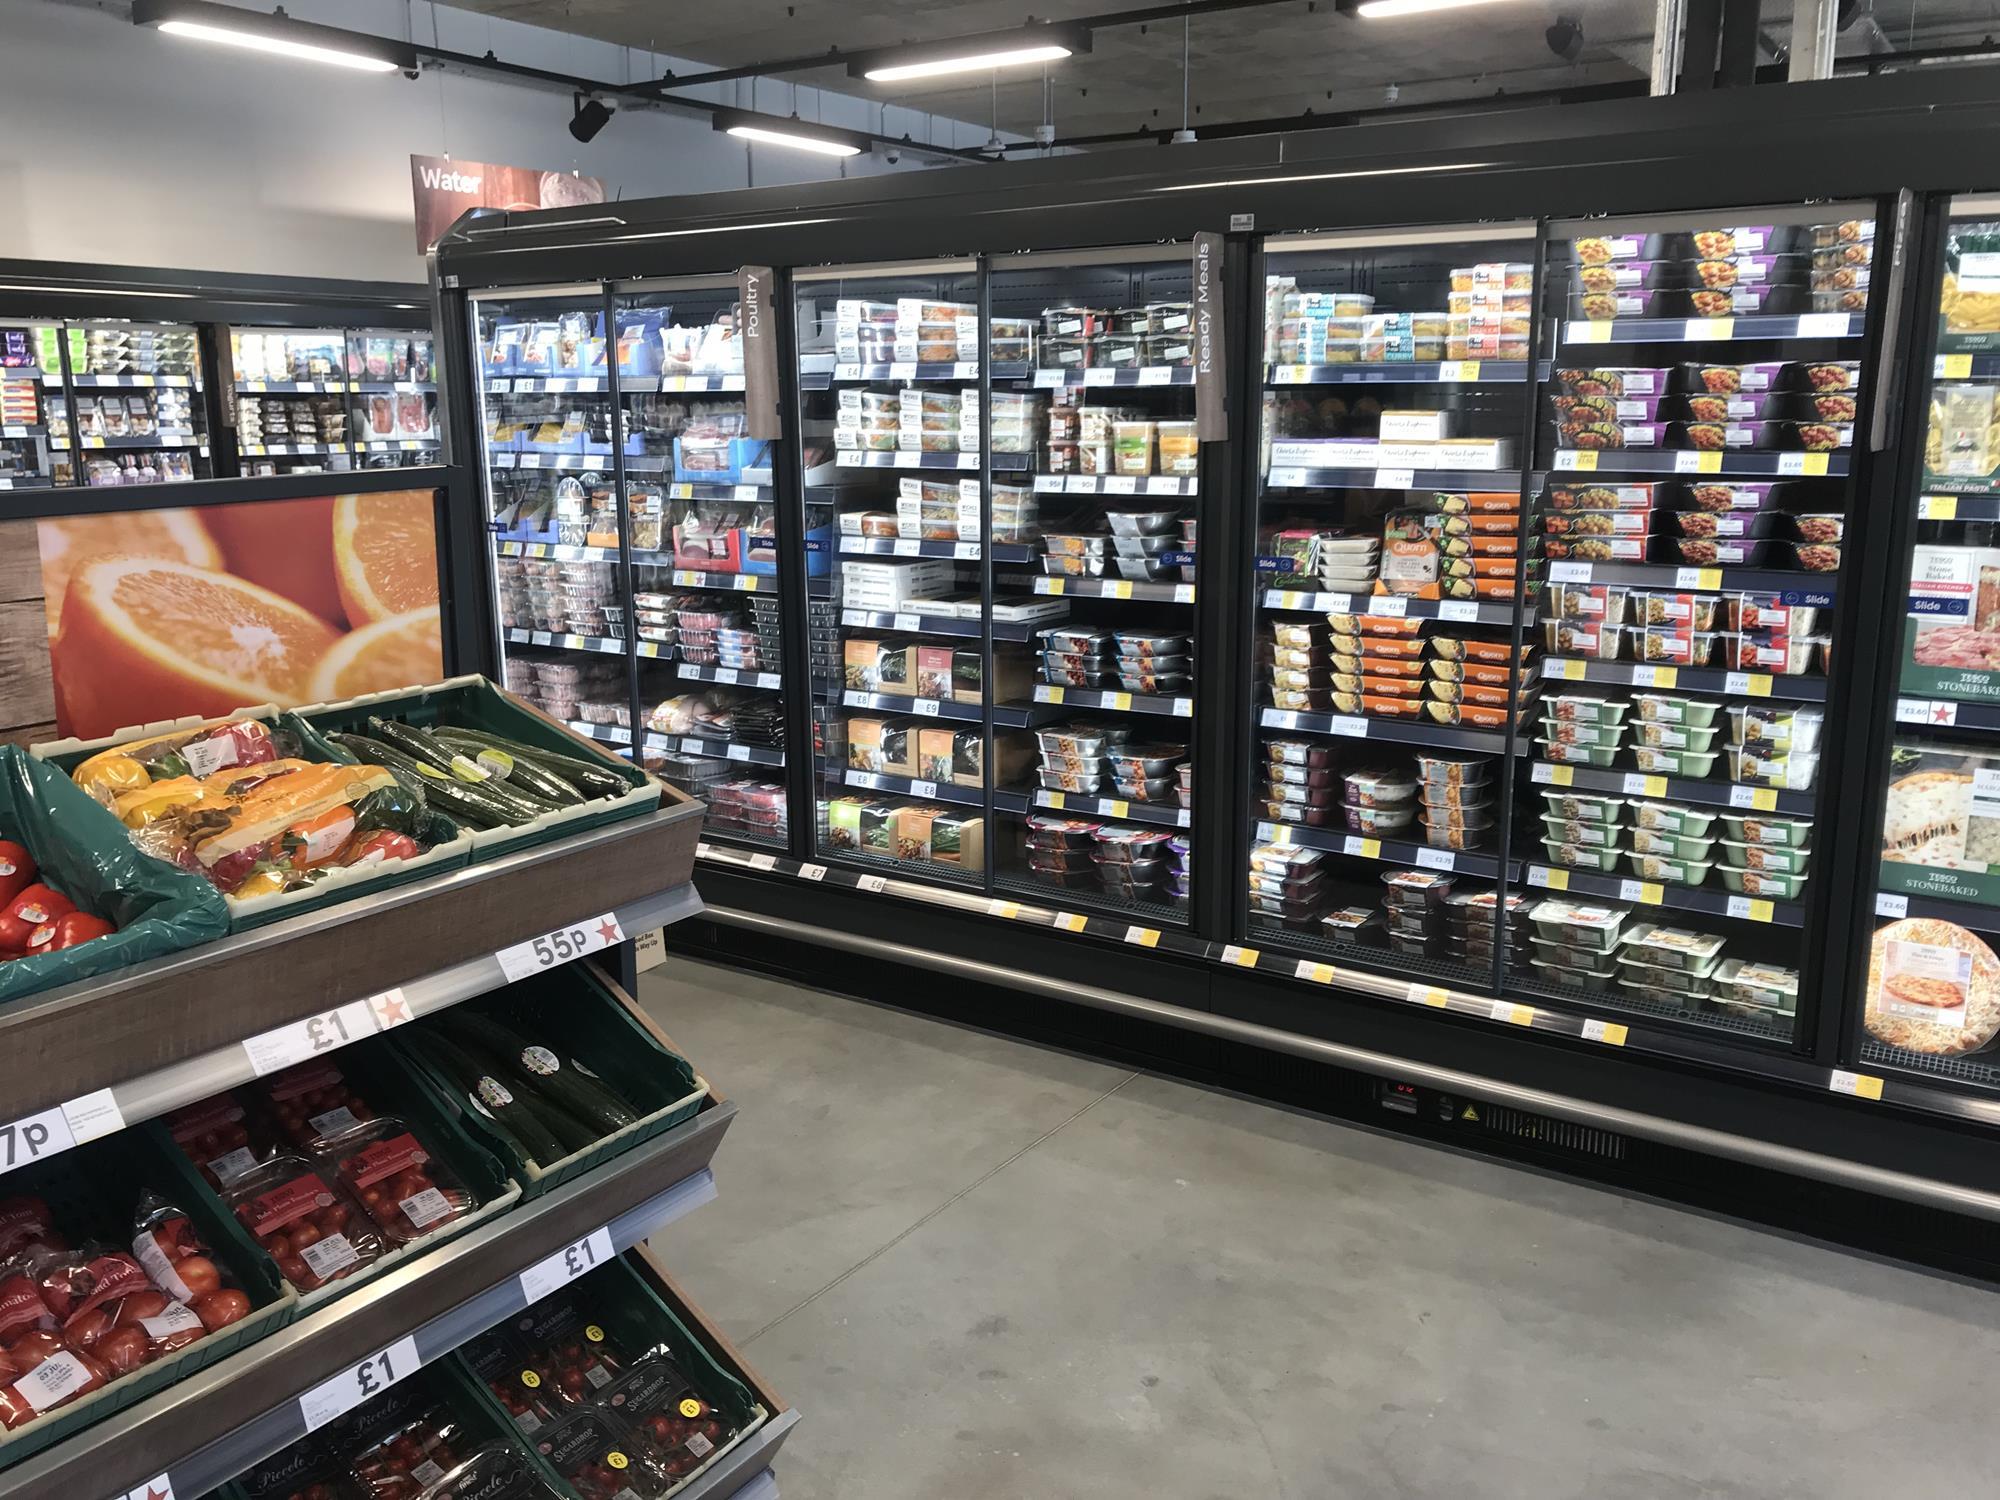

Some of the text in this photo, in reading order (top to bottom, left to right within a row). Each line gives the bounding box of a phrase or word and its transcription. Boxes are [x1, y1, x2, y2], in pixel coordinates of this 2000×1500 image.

[420, 166, 482, 194] Water
[748, 274, 760, 338] Poultry
[1197, 242, 1212, 374] Ready Meals
[1484, 502, 1510, 510] Quorn
[969, 548, 980, 557] £4
[1394, 542, 1427, 553] Quorn
[1176, 554, 1192, 563] Slide
[1259, 560, 1276, 568] Slide
[1805, 595, 1830, 605] Slide
[1914, 600, 1941, 611] Slide
[1373, 624, 1397, 632] Quorn
[1376, 645, 1400, 653] Quorn
[1479, 650, 1504, 658] Quorn
[690, 668, 699, 678] £3
[1477, 671, 1502, 681] Quorn
[1960, 672, 1990, 684] TESCO
[1376, 684, 1400, 692] Quorn
[1936, 681, 2000, 696] STONEBAKE
[856, 695, 867, 704] £8
[1476, 693, 1502, 702] Quorn
[926, 704, 937, 713] £9
[1376, 704, 1399, 712] Quorn
[1473, 714, 1499, 723] Quorn
[856, 775, 867, 785] £8
[923, 784, 935, 795] £8
[810, 868, 823, 878] £7
[1928, 872, 1958, 883] TESCO
[871, 879, 884, 890] £8
[1905, 879, 1979, 897] STONEBAKED
[532, 930, 587, 966] 55p
[306, 1010, 350, 1051] £1
[0, 1123, 49, 1166] 7p
[565, 1238, 595, 1277] £1
[357, 1351, 396, 1397] £1
[627, 1376, 666, 1412] SUGARDROP
[352, 1400, 398, 1433] Piccolo
[553, 1427, 594, 1463] SUGARDROP
[257, 1454, 305, 1489] Piccolo
